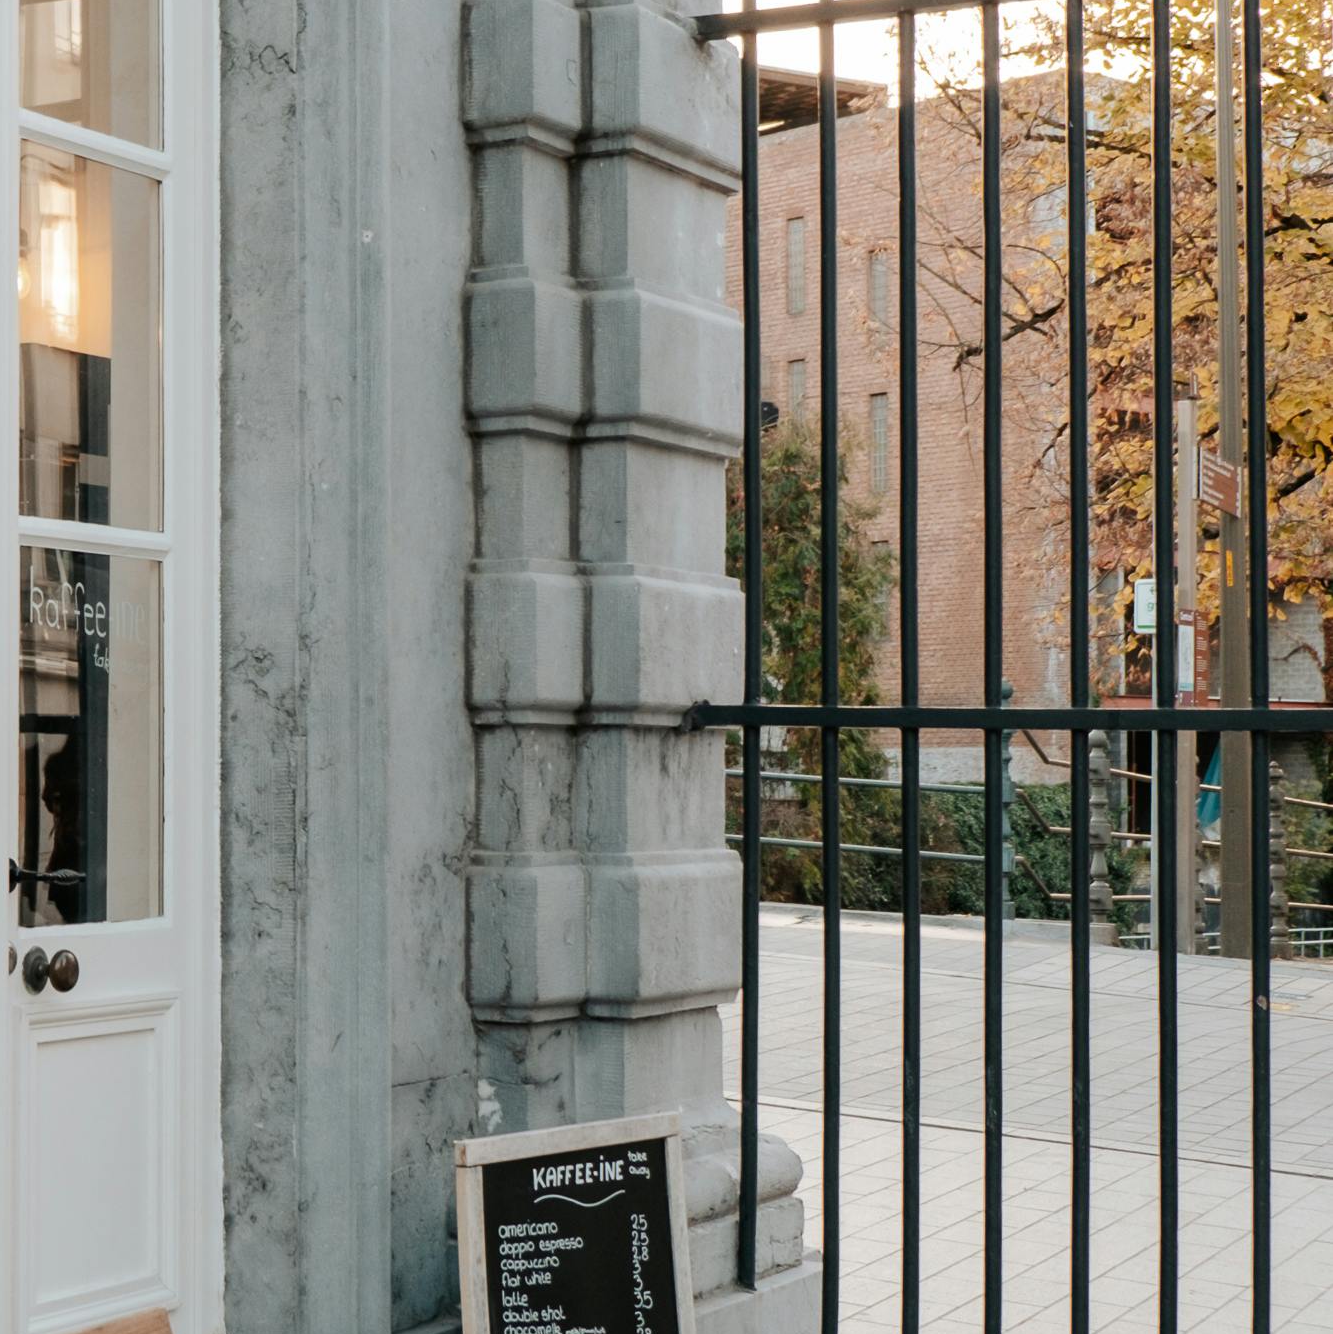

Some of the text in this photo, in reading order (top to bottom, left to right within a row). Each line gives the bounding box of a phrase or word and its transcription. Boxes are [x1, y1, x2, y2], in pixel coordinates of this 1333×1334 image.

[498, 1219, 558, 1239] americano
[499, 1240, 535, 1259] doppio
[539, 1236, 584, 1254] espresso
[500, 1255, 560, 1272] cappuccino
[501, 1259, 642, 1287] flat white 3
[501, 1274, 644, 1307] latte 3
[502, 1308, 539, 1323] double
[541, 1304, 566, 1321] shot
[634, 1310, 645, 1328] 3
